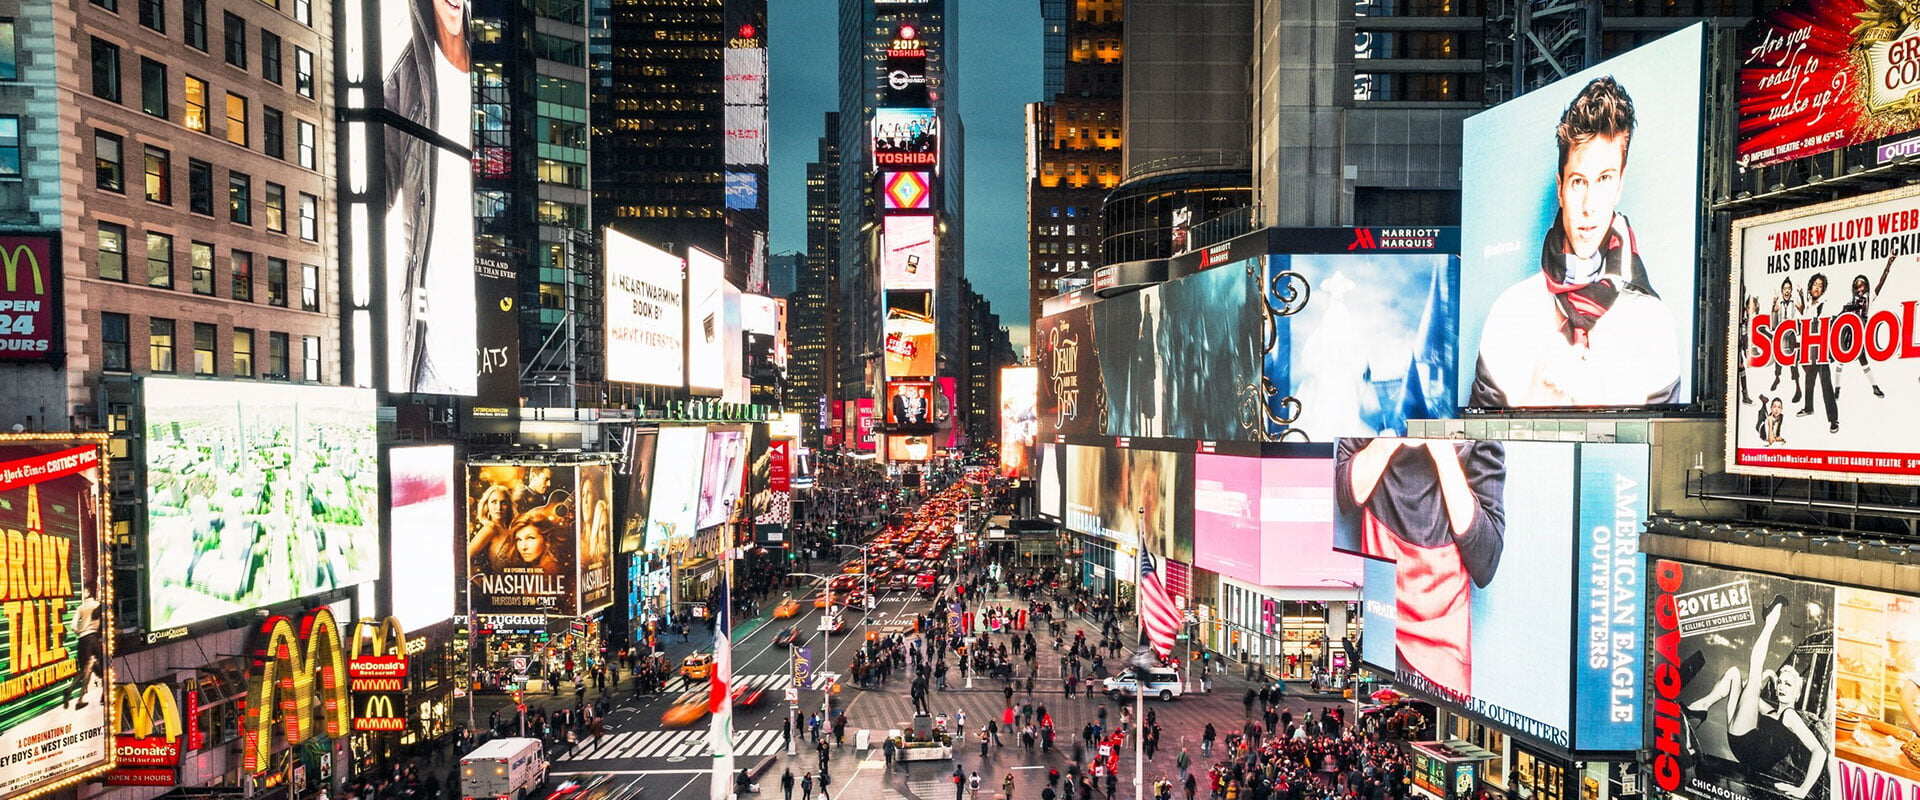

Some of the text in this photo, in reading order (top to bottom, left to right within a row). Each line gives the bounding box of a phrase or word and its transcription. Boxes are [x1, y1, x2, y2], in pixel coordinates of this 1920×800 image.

[893, 40, 920, 50] 2017
[1745, 25, 1812, 67] Are you
[1759, 43, 1819, 100] ready to
[1885, 58, 1920, 90] CO
[1768, 72, 1847, 126] wake up?
[877, 153, 936, 164] TOSHIBA
[1751, 147, 1775, 162] IMPERIAL
[1776, 140, 1800, 155] THEATRE
[1381, 229, 1440, 237] MARRIOTT
[1831, 216, 1873, 243] LLOYD
[1878, 208, 1919, 235] WEBB
[1381, 240, 1433, 248] MARQUIS
[483, 266, 499, 276] THAN
[496, 261, 509, 270] AND
[1767, 251, 1791, 275] HAS
[1794, 241, 1868, 271] BROADWAY
[619, 274, 681, 307] HEARTWARMING
[632, 299, 663, 320] BOOK BY
[0, 314, 34, 335] 24
[1749, 301, 1920, 368] SCHOOL
[4, 469, 23, 483] York
[24, 464, 46, 478] Times
[80, 449, 97, 465] PICK
[1828, 456, 1849, 465] WINTER
[1850, 456, 1873, 467] GARDEN
[1875, 458, 1901, 468] THEATRE
[27, 483, 41, 530] A
[482, 574, 565, 595] NASHVILLE
[1590, 525, 1611, 669] OUTFITTERS
[492, 596, 521, 606] THURSDAYS
[536, 596, 557, 606] CMT
[1611, 474, 1638, 723] AMERICAN EAGLE
[1678, 586, 1748, 617] 20 YEARS
[488, 615, 546, 625] LUGGAGE
[1685, 621, 1705, 631] KILLING
[1713, 613, 1747, 625] WORLDWIDE
[3, 598, 67, 675] TALE
[351, 662, 405, 670] McDonald's
[1654, 559, 1684, 792] CHICAGO
[1451, 688, 1486, 714] EAGLE
[1488, 703, 1568, 748] OUTFITTERS
[12, 748, 33, 764] BOYS
[41, 739, 62, 754] WEST
[63, 734, 78, 748] SIDE
[23, 726, 65, 747] COMBINATION
[117, 746, 176, 756] cDonald's
